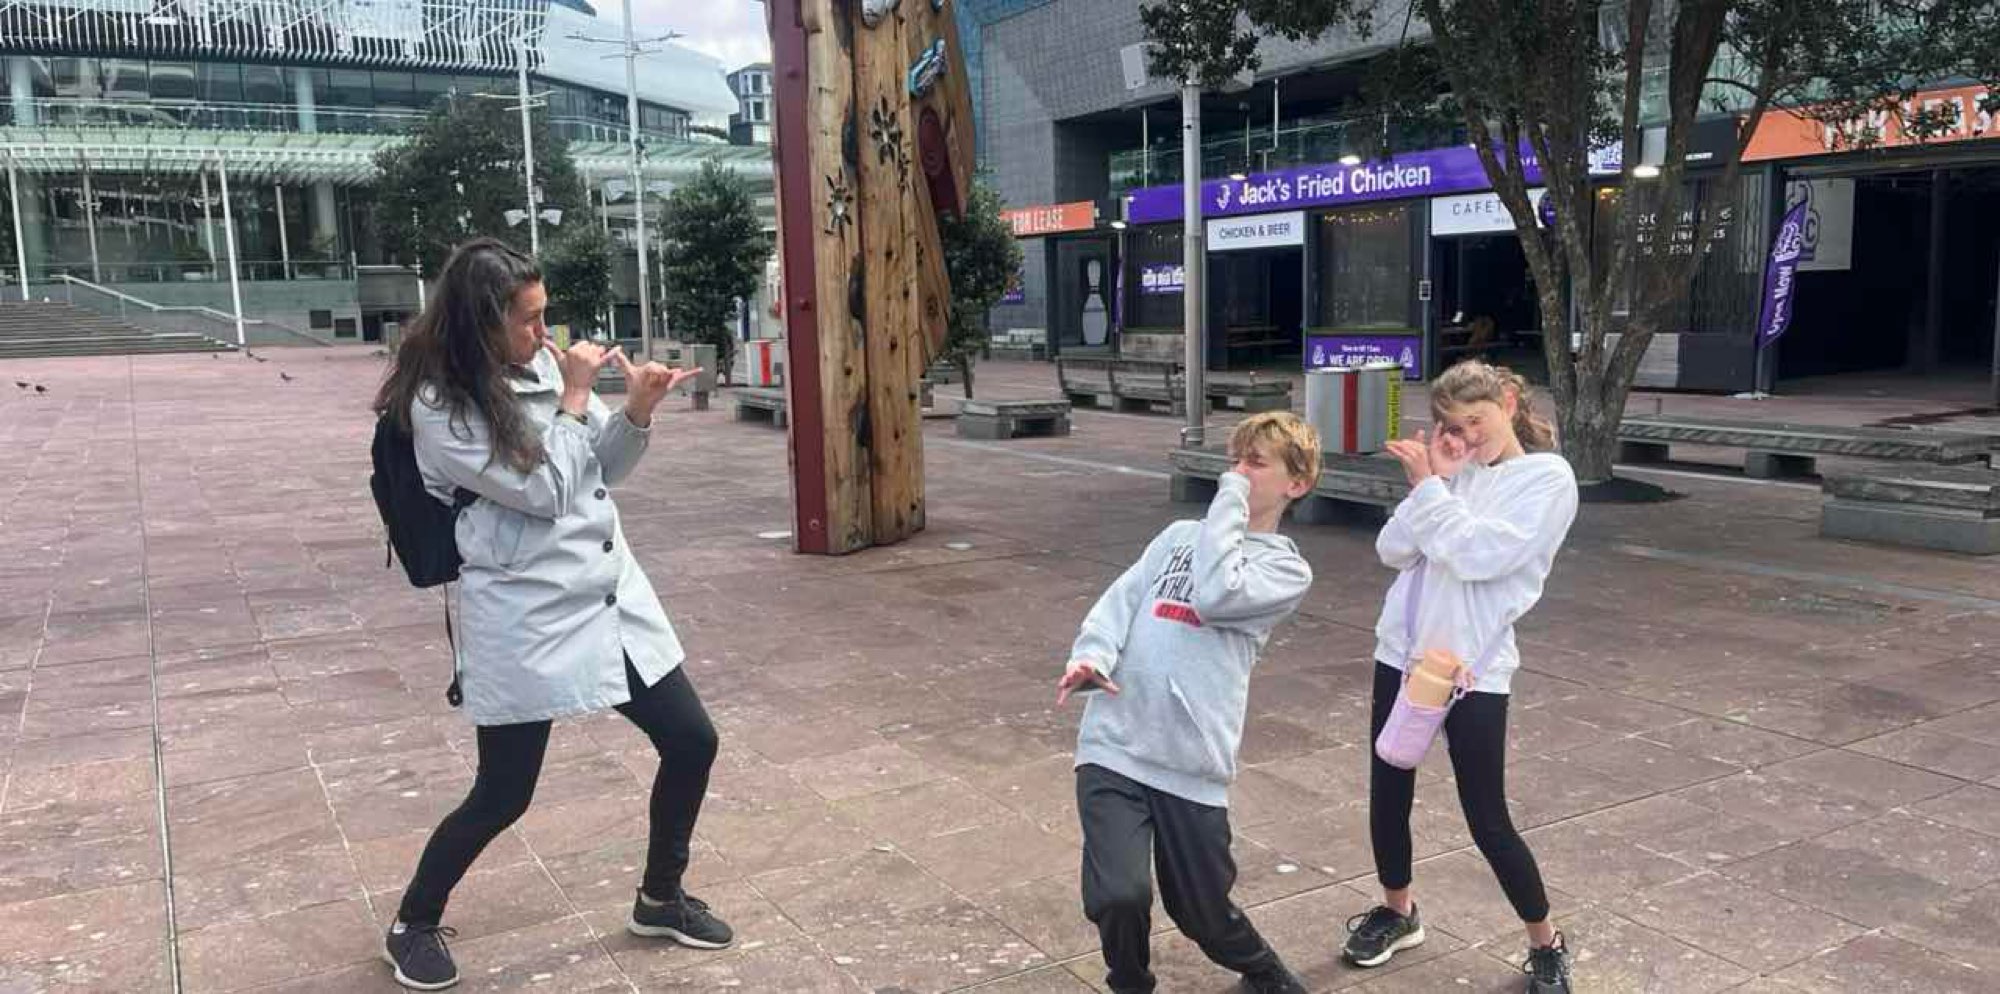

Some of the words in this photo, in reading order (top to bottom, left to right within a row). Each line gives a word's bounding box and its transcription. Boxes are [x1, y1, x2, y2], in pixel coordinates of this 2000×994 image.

[1239, 178, 1291, 206] Jack's
[1297, 170, 1345, 199] Fried
[1351, 163, 1431, 195] Chicken
[1034, 207, 1063, 231] LEASE
[1219, 224, 1257, 239] CHICKEN
[1258, 224, 1265, 237] &
[1266, 221, 1290, 236] BEER
